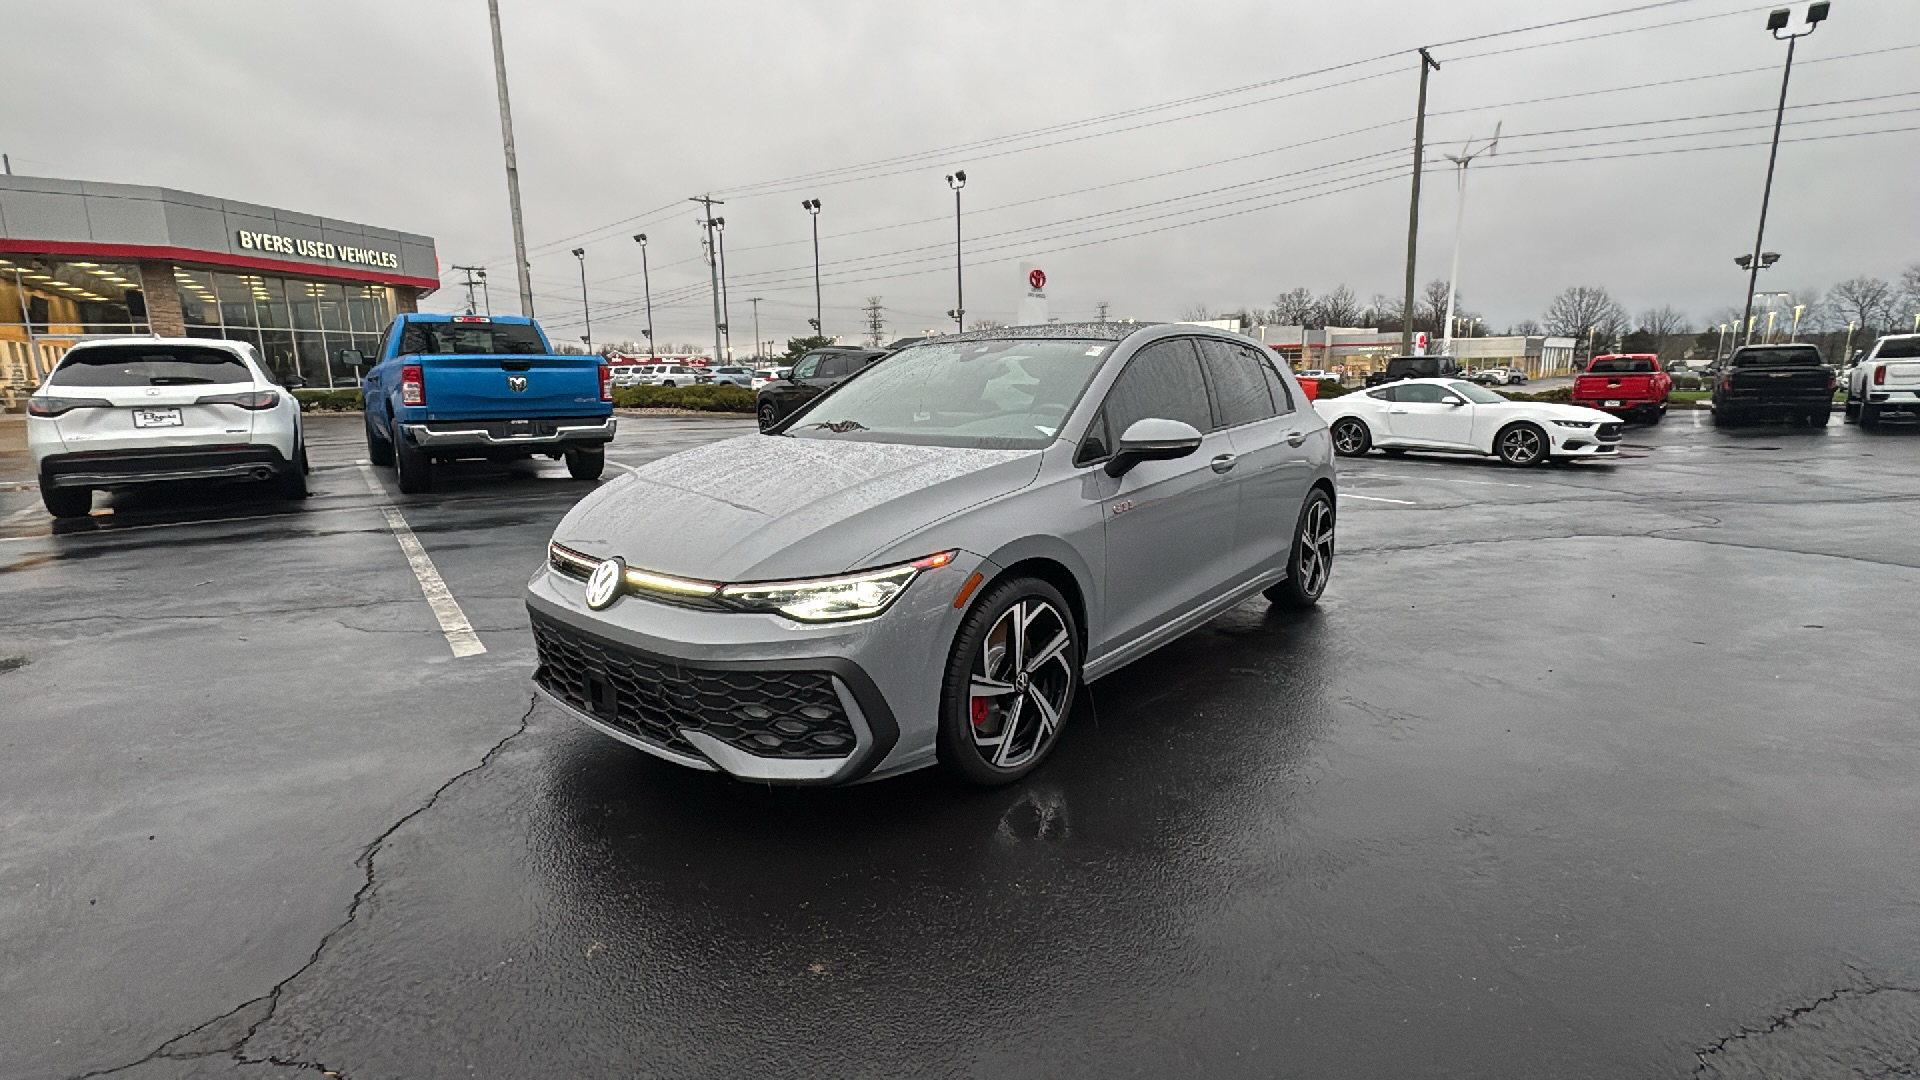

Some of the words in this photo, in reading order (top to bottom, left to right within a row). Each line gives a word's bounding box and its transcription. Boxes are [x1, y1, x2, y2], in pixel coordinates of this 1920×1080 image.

[239, 230, 294, 254] BYERS
[295, 239, 335, 259] USED
[337, 245, 398, 269] VEHICLES
